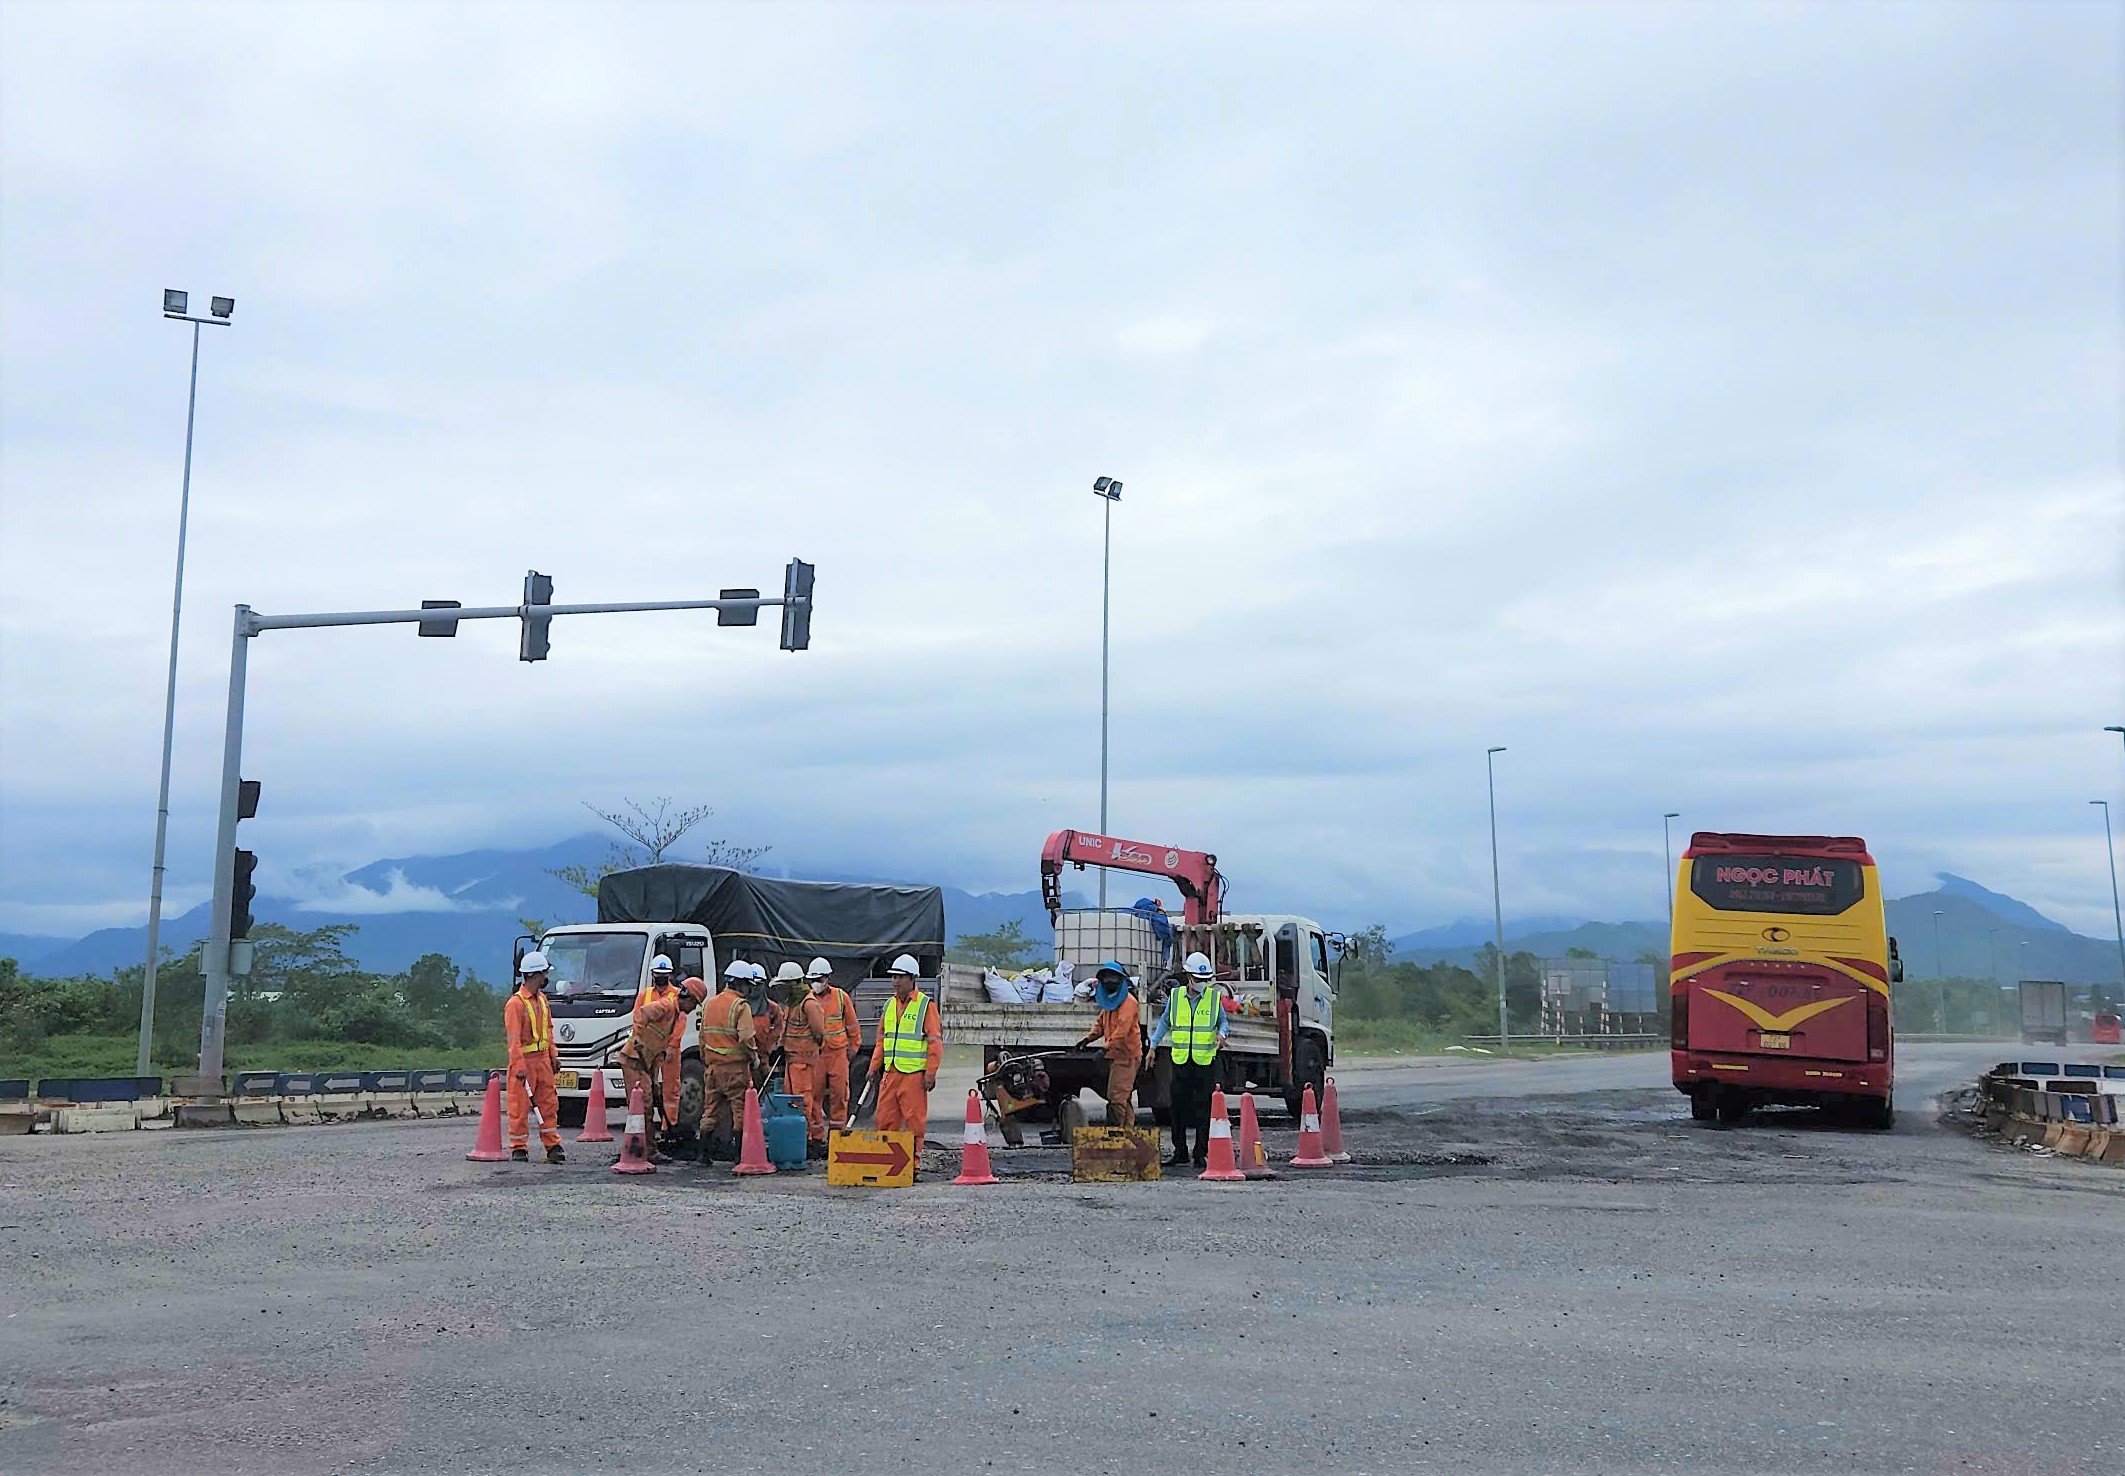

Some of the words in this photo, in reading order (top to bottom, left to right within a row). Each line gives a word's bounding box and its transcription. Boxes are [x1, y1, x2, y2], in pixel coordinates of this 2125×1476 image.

[1079, 836, 1102, 848] UNIC
[1716, 867, 1779, 887] NGỌC
[903, 1013, 917, 1021] VEC
